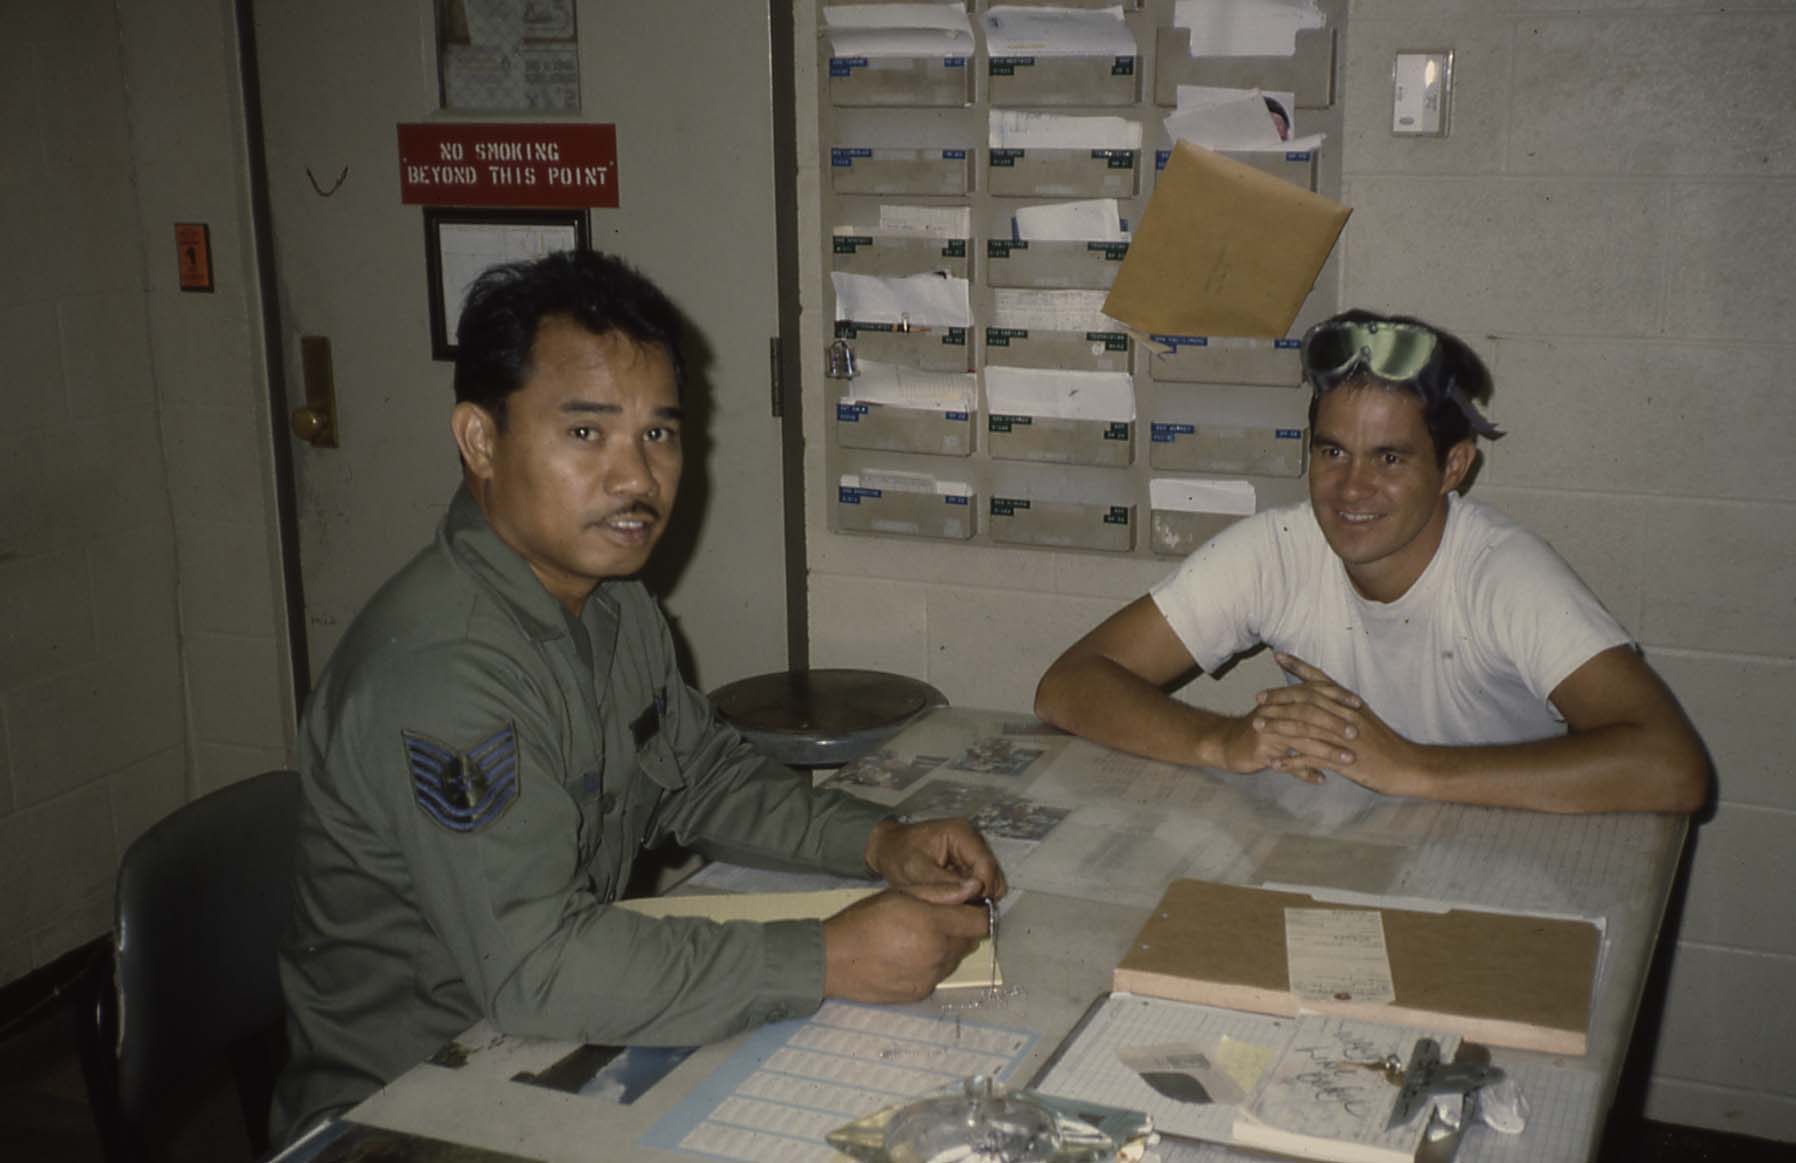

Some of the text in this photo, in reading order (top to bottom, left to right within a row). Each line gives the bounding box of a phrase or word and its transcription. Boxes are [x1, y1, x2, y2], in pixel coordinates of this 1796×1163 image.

[440, 142, 560, 161] NO SMOKING
[408, 166, 607, 185] BEYOND THIS POINT
